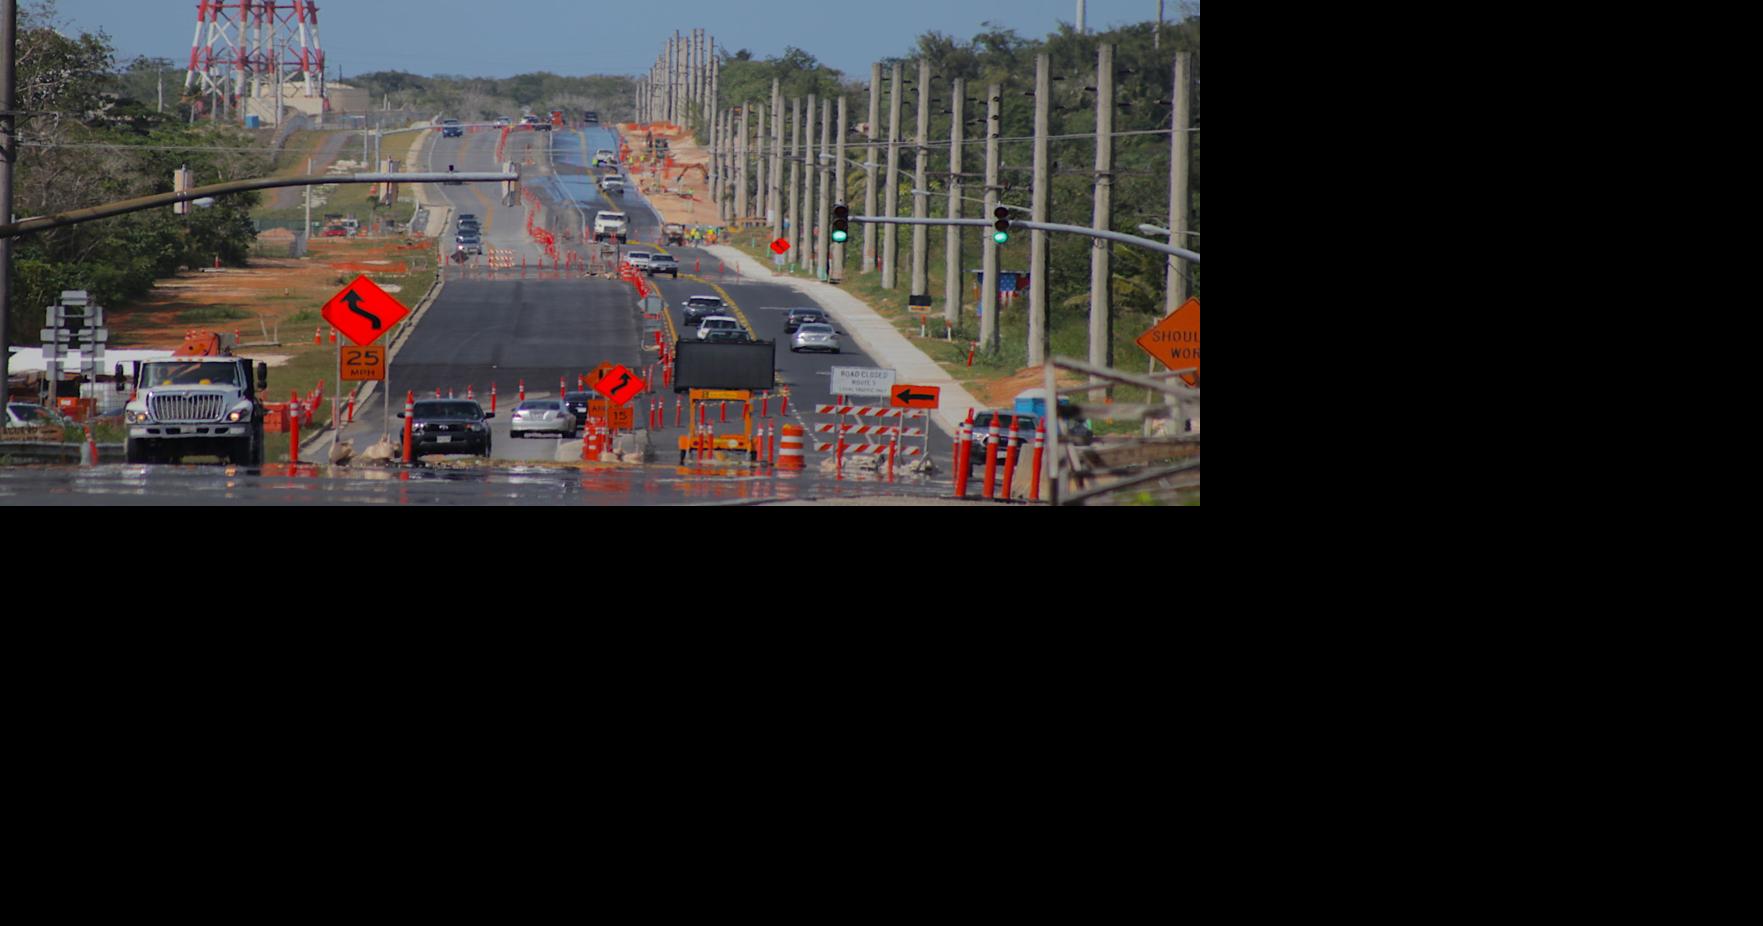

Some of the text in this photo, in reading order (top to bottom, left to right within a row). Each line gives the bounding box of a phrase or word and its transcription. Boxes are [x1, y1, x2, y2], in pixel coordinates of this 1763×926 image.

[347, 350, 379, 366] 25
[840, 370, 889, 379] ROAD CLOSED
